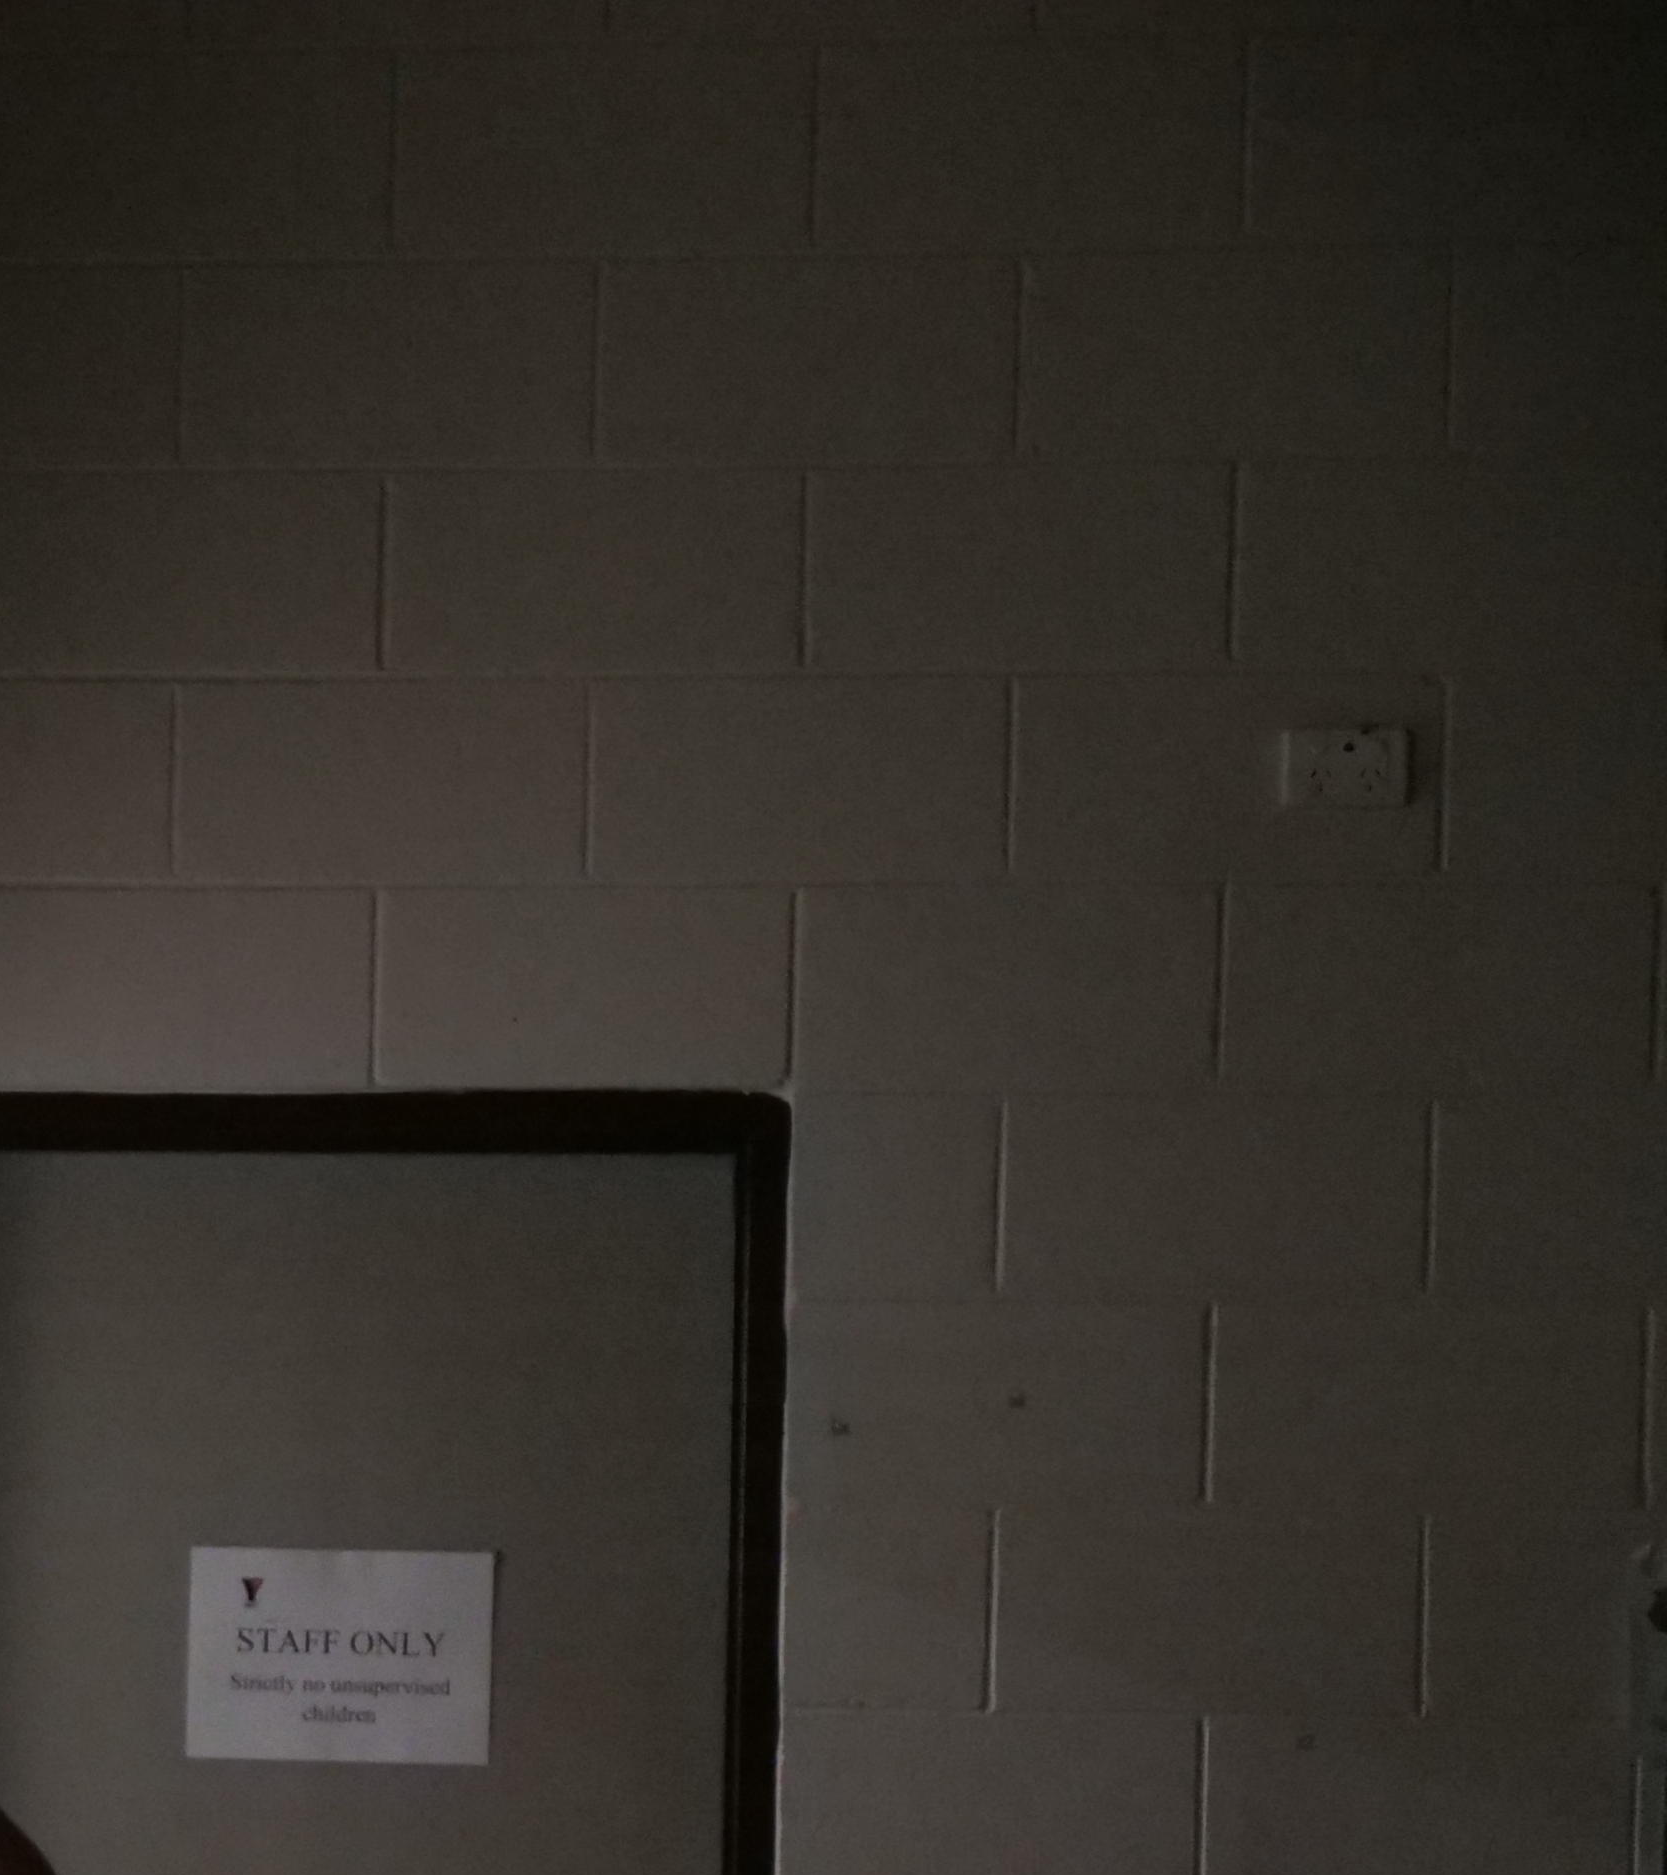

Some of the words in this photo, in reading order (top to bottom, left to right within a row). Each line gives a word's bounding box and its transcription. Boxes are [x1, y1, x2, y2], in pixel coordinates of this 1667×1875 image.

[236, 1627, 340, 1654] STAFF
[350, 1630, 445, 1656] ONLY
[302, 1679, 326, 1692] no
[328, 1678, 451, 1697] unsupervised
[302, 1705, 377, 1723] children
